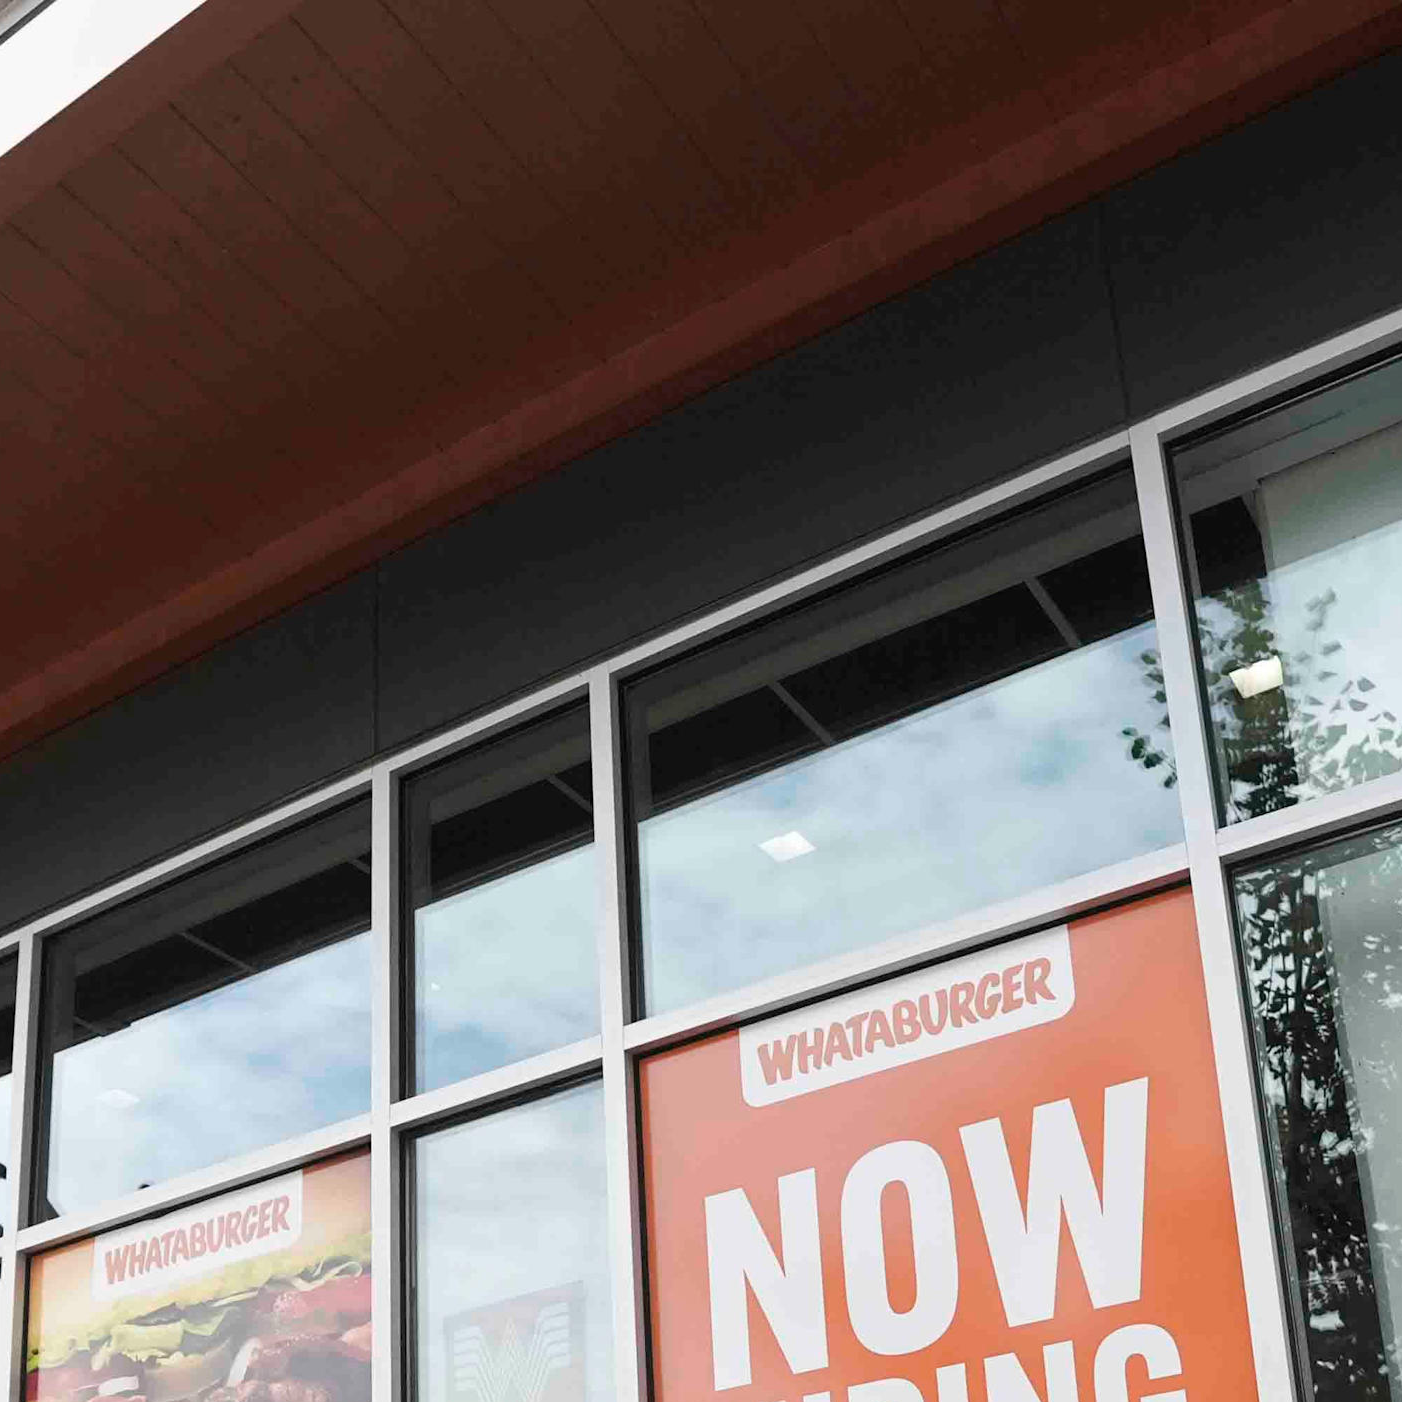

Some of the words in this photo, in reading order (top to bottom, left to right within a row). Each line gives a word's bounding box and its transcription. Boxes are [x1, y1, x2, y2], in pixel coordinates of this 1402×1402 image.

[756, 956, 1056, 1086] WHATABURGER
[102, 1193, 291, 1286] WHATABURGER
[703, 1076, 1149, 1393] NOW
